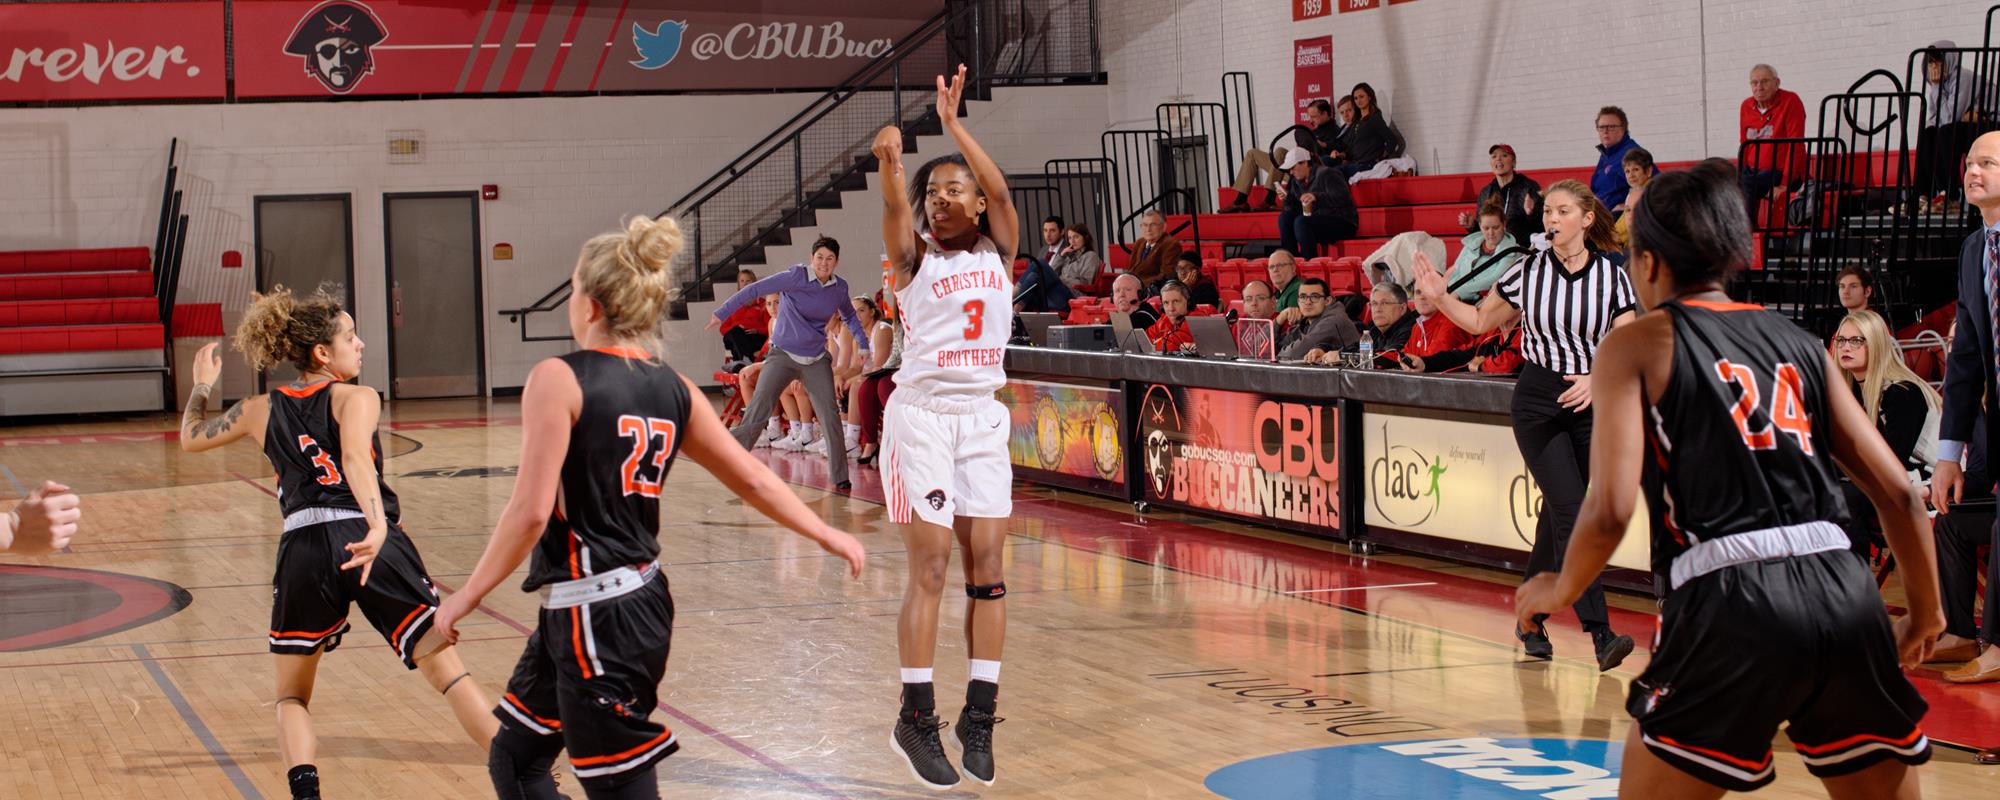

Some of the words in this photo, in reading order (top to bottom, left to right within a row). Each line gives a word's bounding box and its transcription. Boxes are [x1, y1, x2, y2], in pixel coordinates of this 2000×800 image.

[1302, 0, 1322, 16] 1959
[0, 39, 200, 85] rever.
[691, 20, 895, 61] @CBUBucs
[1297, 52, 1330, 67] BASKETBALL
[931, 270, 1003, 299] CHRISTIAN
[962, 299, 985, 341] 3
[937, 347, 1002, 368] BROTHERS
[1714, 357, 1814, 457] 24
[298, 434, 342, 486] 3
[617, 414, 677, 498] 23
[1180, 442, 1257, 468] gobucsgo.com
[1254, 400, 1339, 482] CBU
[1172, 456, 1341, 531] BUCCANEERS
[1207, 678, 1446, 737] Division
